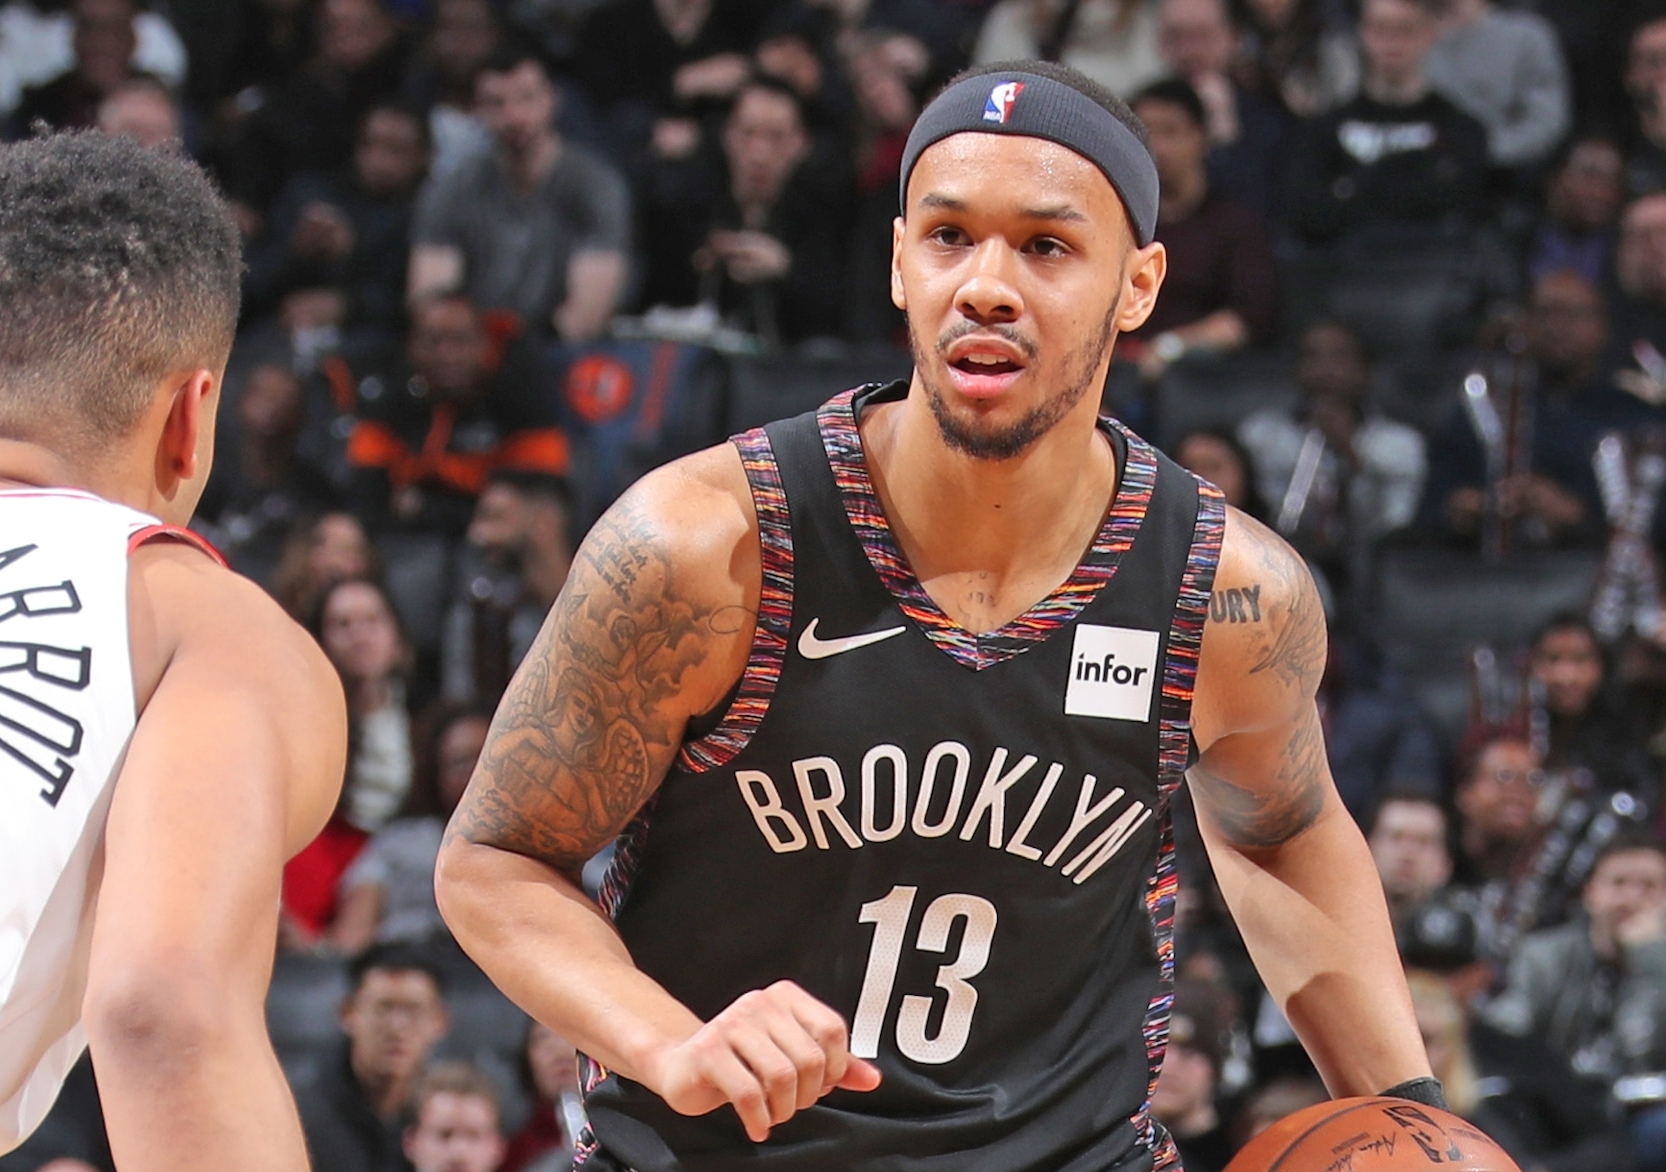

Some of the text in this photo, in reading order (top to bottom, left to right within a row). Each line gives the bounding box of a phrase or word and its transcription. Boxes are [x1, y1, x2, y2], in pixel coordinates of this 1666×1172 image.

[1209, 584, 1262, 624] URY
[1076, 651, 1149, 688] infor
[734, 740, 1153, 885] BROOKLYN
[850, 884, 998, 1065] 13
